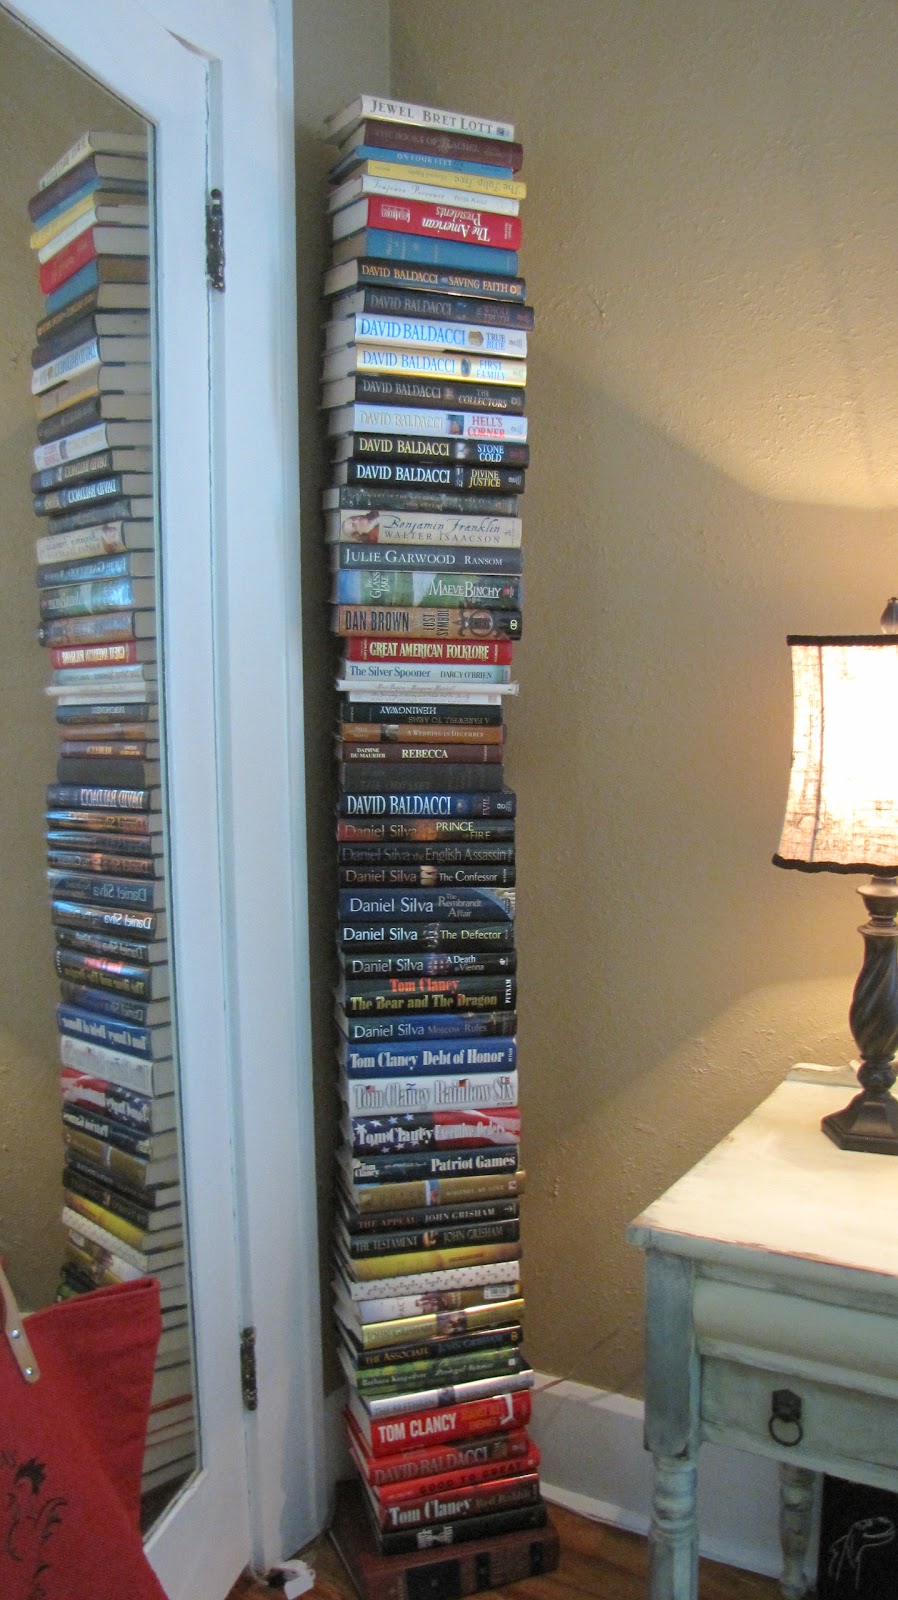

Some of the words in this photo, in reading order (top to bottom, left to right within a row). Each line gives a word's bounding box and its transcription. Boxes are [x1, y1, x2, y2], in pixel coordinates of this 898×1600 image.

[370, 100, 413, 118] JEWEL
[423, 110, 456, 127] BRET
[460, 118, 493, 134] LOTT
[503, 183, 521, 196] The
[436, 207, 481, 225] Presidents
[422, 218, 468, 238] American
[472, 228, 490, 242] The
[362, 265, 390, 277] DAVID
[394, 268, 438, 284] BALDACCI
[449, 277, 480, 289] SAVING
[482, 280, 508, 293] FAITH
[370, 295, 401, 309] DAVID
[404, 300, 451, 316] BALDACCI
[361, 319, 401, 337] DAVID
[403, 327, 466, 345] BALDACCI
[486, 333, 505, 342] TRUE
[486, 341, 505, 351] BLUE
[363, 351, 397, 366] DAVID
[401, 355, 455, 373] BALDACCI
[363, 380, 392, 393] DAVID
[395, 384, 441, 399] BALDACCI
[458, 394, 508, 408] COLLECTORS
[359, 411, 390, 425] DAVID
[394, 415, 443, 429] BALDACCI
[467, 427, 505, 438] CORNER
[359, 439, 393, 452] DAVID
[397, 441, 449, 456] BALDACCI
[477, 444, 504, 454] STONE
[479, 453, 502, 462] COLD
[357, 465, 391, 480] DAVID
[396, 468, 450, 484] BALDACCI
[471, 469, 499, 479] DIVINE
[469, 478, 500, 488] JUSTICE
[383, 515, 445, 536] Benjamin
[447, 518, 500, 533] Franklin
[384, 531, 432, 540] WALTER
[439, 532, 500, 543] ISAACSON
[345, 549, 381, 563] JULIE
[385, 550, 455, 565] GARWOOD
[465, 583, 501, 598] BINCHY
[345, 610, 366, 631] DAN
[371, 612, 409, 632] BROWN
[369, 642, 397, 657] GREAT
[400, 643, 443, 659] AMERICAN
[447, 645, 489, 660] FOLKLORE
[350, 666, 366, 676] The
[368, 666, 393, 677] Silver
[394, 668, 431, 678] Spooner
[379, 706, 437, 715] HEMINGWAY
[402, 749, 448, 759] REBECCA
[347, 795, 385, 815] DAVID
[390, 796, 451, 816] BALDACCI
[345, 825, 384, 838] Daniel
[390, 825, 417, 839] Silva
[436, 822, 473, 832] PRINCE
[470, 831, 491, 840] FIRE
[342, 848, 380, 861] Daniel
[384, 848, 409, 861] Silva
[425, 848, 461, 863] English
[465, 849, 506, 861] Assassin
[346, 870, 384, 882] Daniel
[390, 870, 417, 882] Silva
[440, 873, 453, 881] The
[455, 871, 497, 881] Confessor
[350, 898, 395, 912] Daniel
[401, 897, 433, 912] Silva
[438, 896, 482, 907] Rembrandt
[343, 928, 384, 941] Daniel
[390, 928, 417, 941] Silva
[440, 930, 457, 939] The
[461, 930, 501, 940] Defector
[352, 960, 391, 973] Daniel
[397, 959, 423, 972] Silva
[460, 963, 484, 971] Vienna
[390, 979, 416, 992] Tom
[419, 978, 459, 993] Clancy
[350, 997, 372, 1010] The
[376, 996, 404, 1009] Bear
[407, 995, 428, 1008] and
[432, 995, 454, 1007] The
[457, 994, 497, 1007] Dragon
[355, 1024, 393, 1038] Daniel
[398, 1024, 424, 1036] Silva
[350, 1054, 375, 1068] Tom
[378, 1052, 418, 1071] Clancy
[423, 1050, 450, 1066] Debt
[453, 1050, 465, 1064] of
[467, 1049, 504, 1064] Honor
[353, 1084, 383, 1109] Tom
[385, 1083, 430, 1110] Clancy
[434, 1080, 491, 1105] Rainbow
[357, 1127, 387, 1144] Tom
[431, 1157, 472, 1172] Patriot
[476, 1155, 515, 1168] Games
[424, 1213, 449, 1222] JOHN
[452, 1208, 495, 1219] GRISHAM
[378, 1426, 405, 1443] TOM
[409, 1413, 456, 1437] CLANCY
[389, 1506, 420, 1525] Tom
[424, 1499, 472, 1518] Clancy
